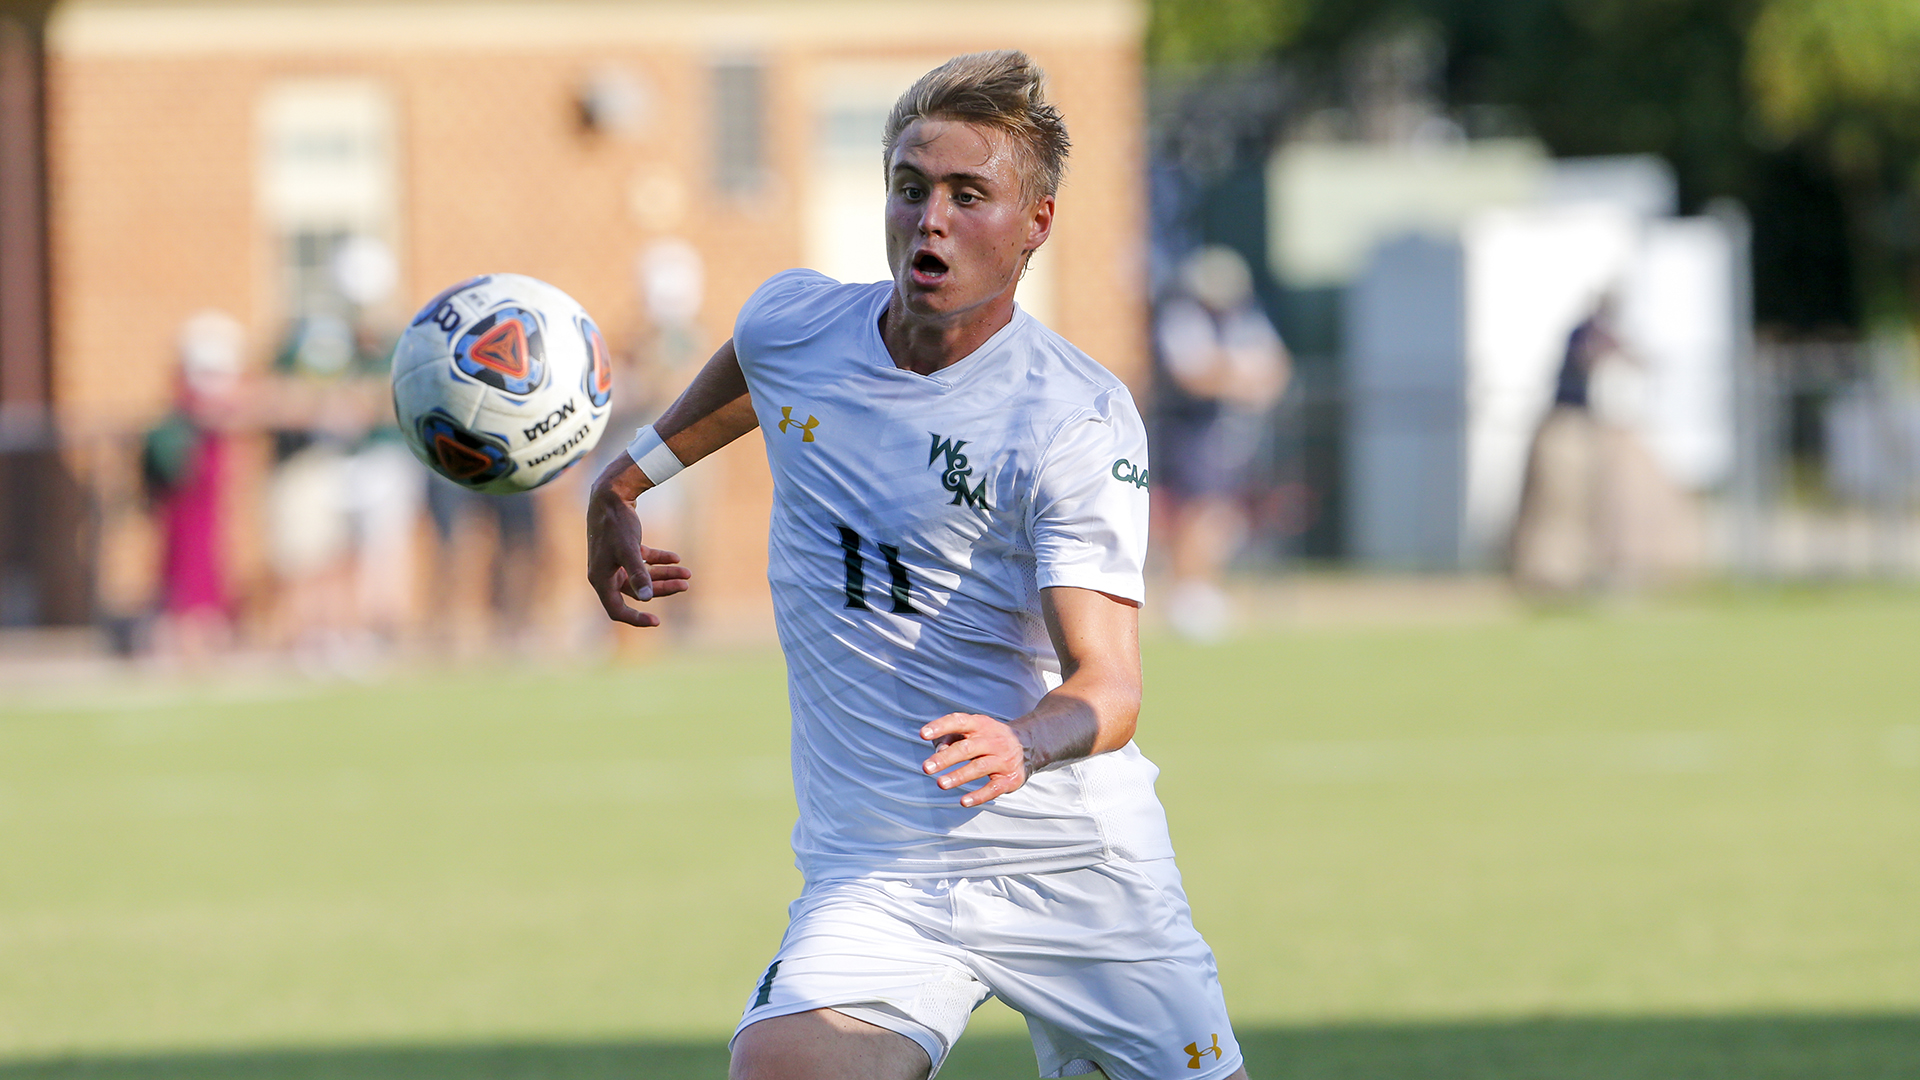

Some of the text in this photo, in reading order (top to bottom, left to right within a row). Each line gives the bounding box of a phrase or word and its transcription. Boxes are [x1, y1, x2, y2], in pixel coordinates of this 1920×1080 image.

[523, 397, 575, 442] NCAA
[527, 425, 589, 468] Wilson
[926, 430, 991, 511] W&M
[1111, 458, 1150, 493] CAA
[830, 521, 922, 616] 11
